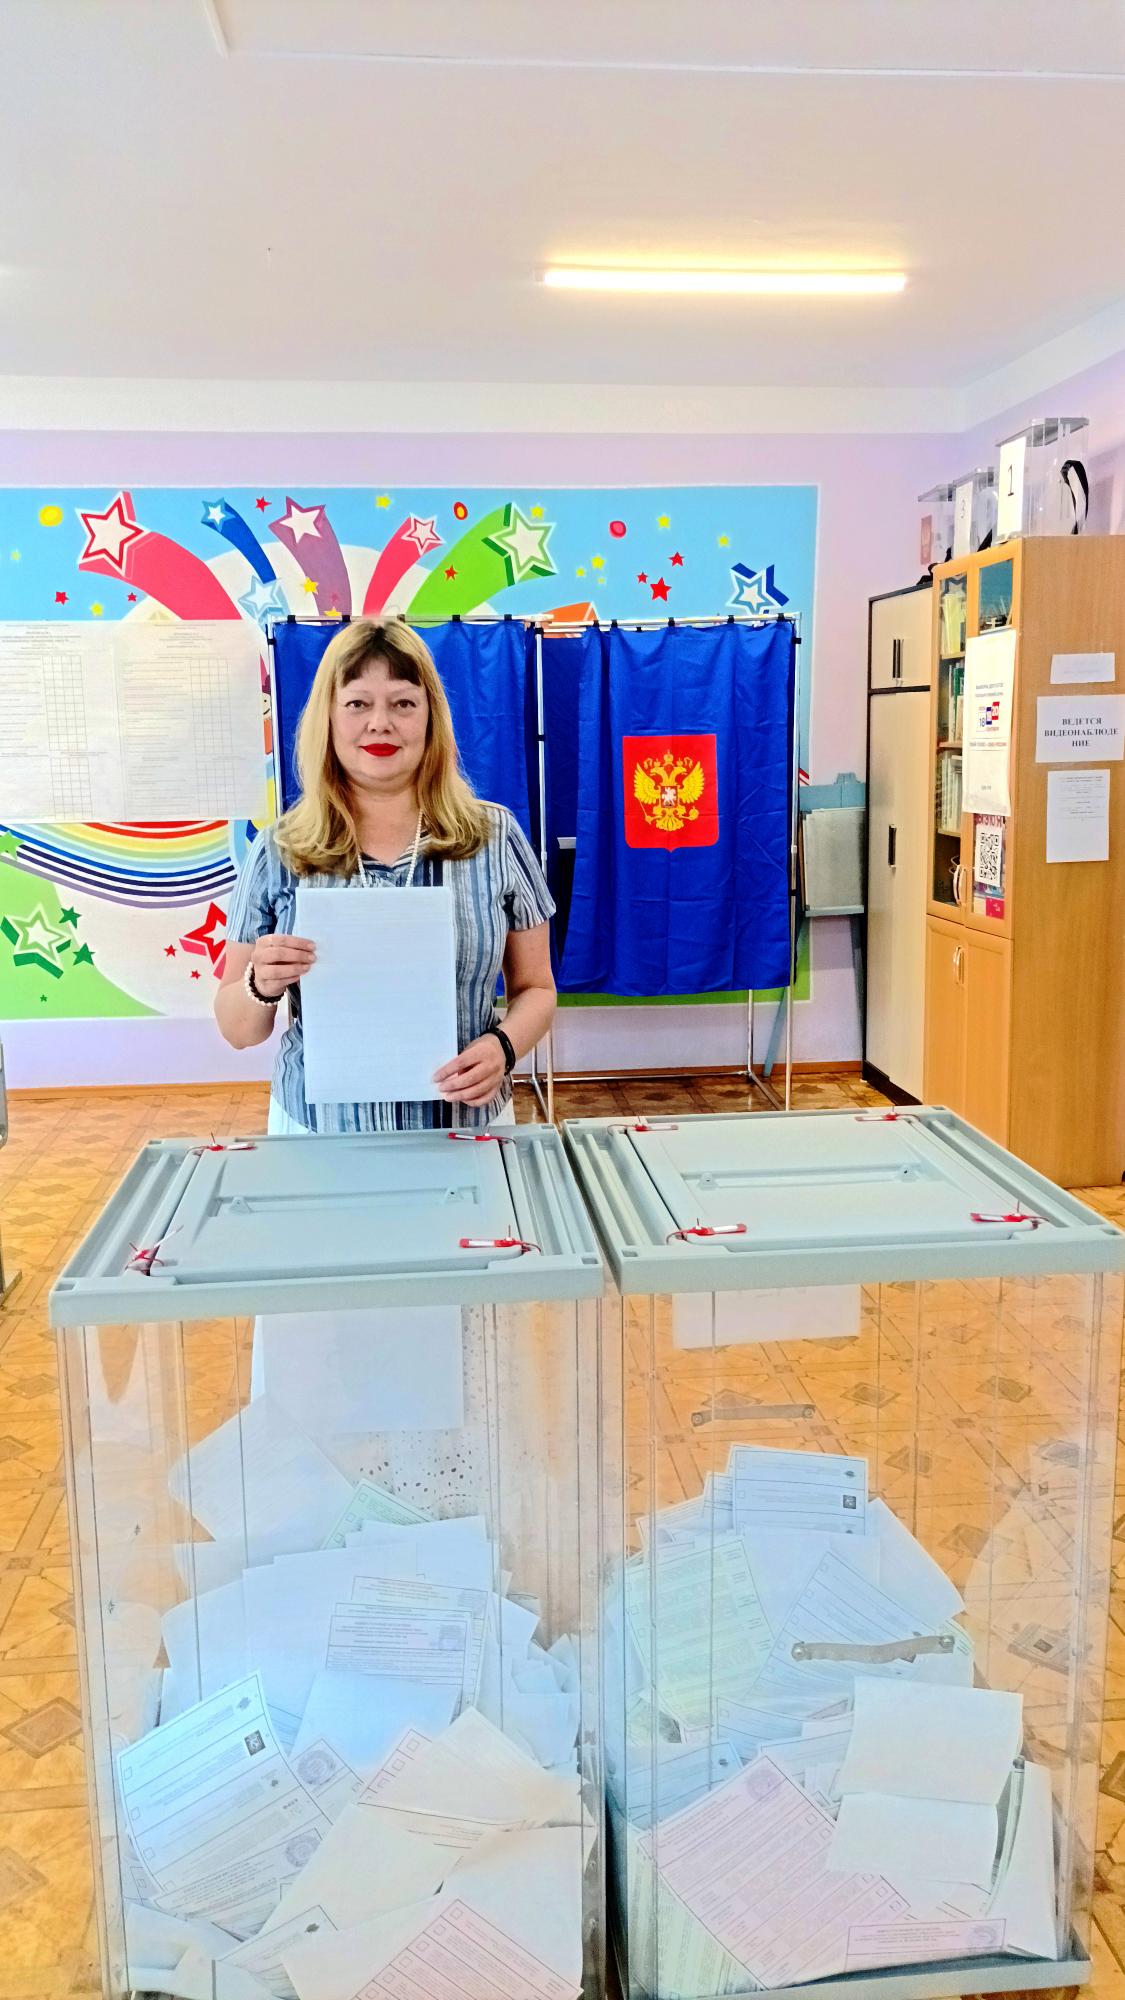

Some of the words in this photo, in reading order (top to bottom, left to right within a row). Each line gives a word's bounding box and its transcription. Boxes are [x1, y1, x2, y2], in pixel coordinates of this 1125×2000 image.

[1008, 464, 1014, 496] 1
[979, 717, 986, 727] 18
[1062, 717, 1102, 726] ВЕДЕТСЯ
[1044, 728, 1119, 737] ВИДЕОНАБЛЮДЕ
